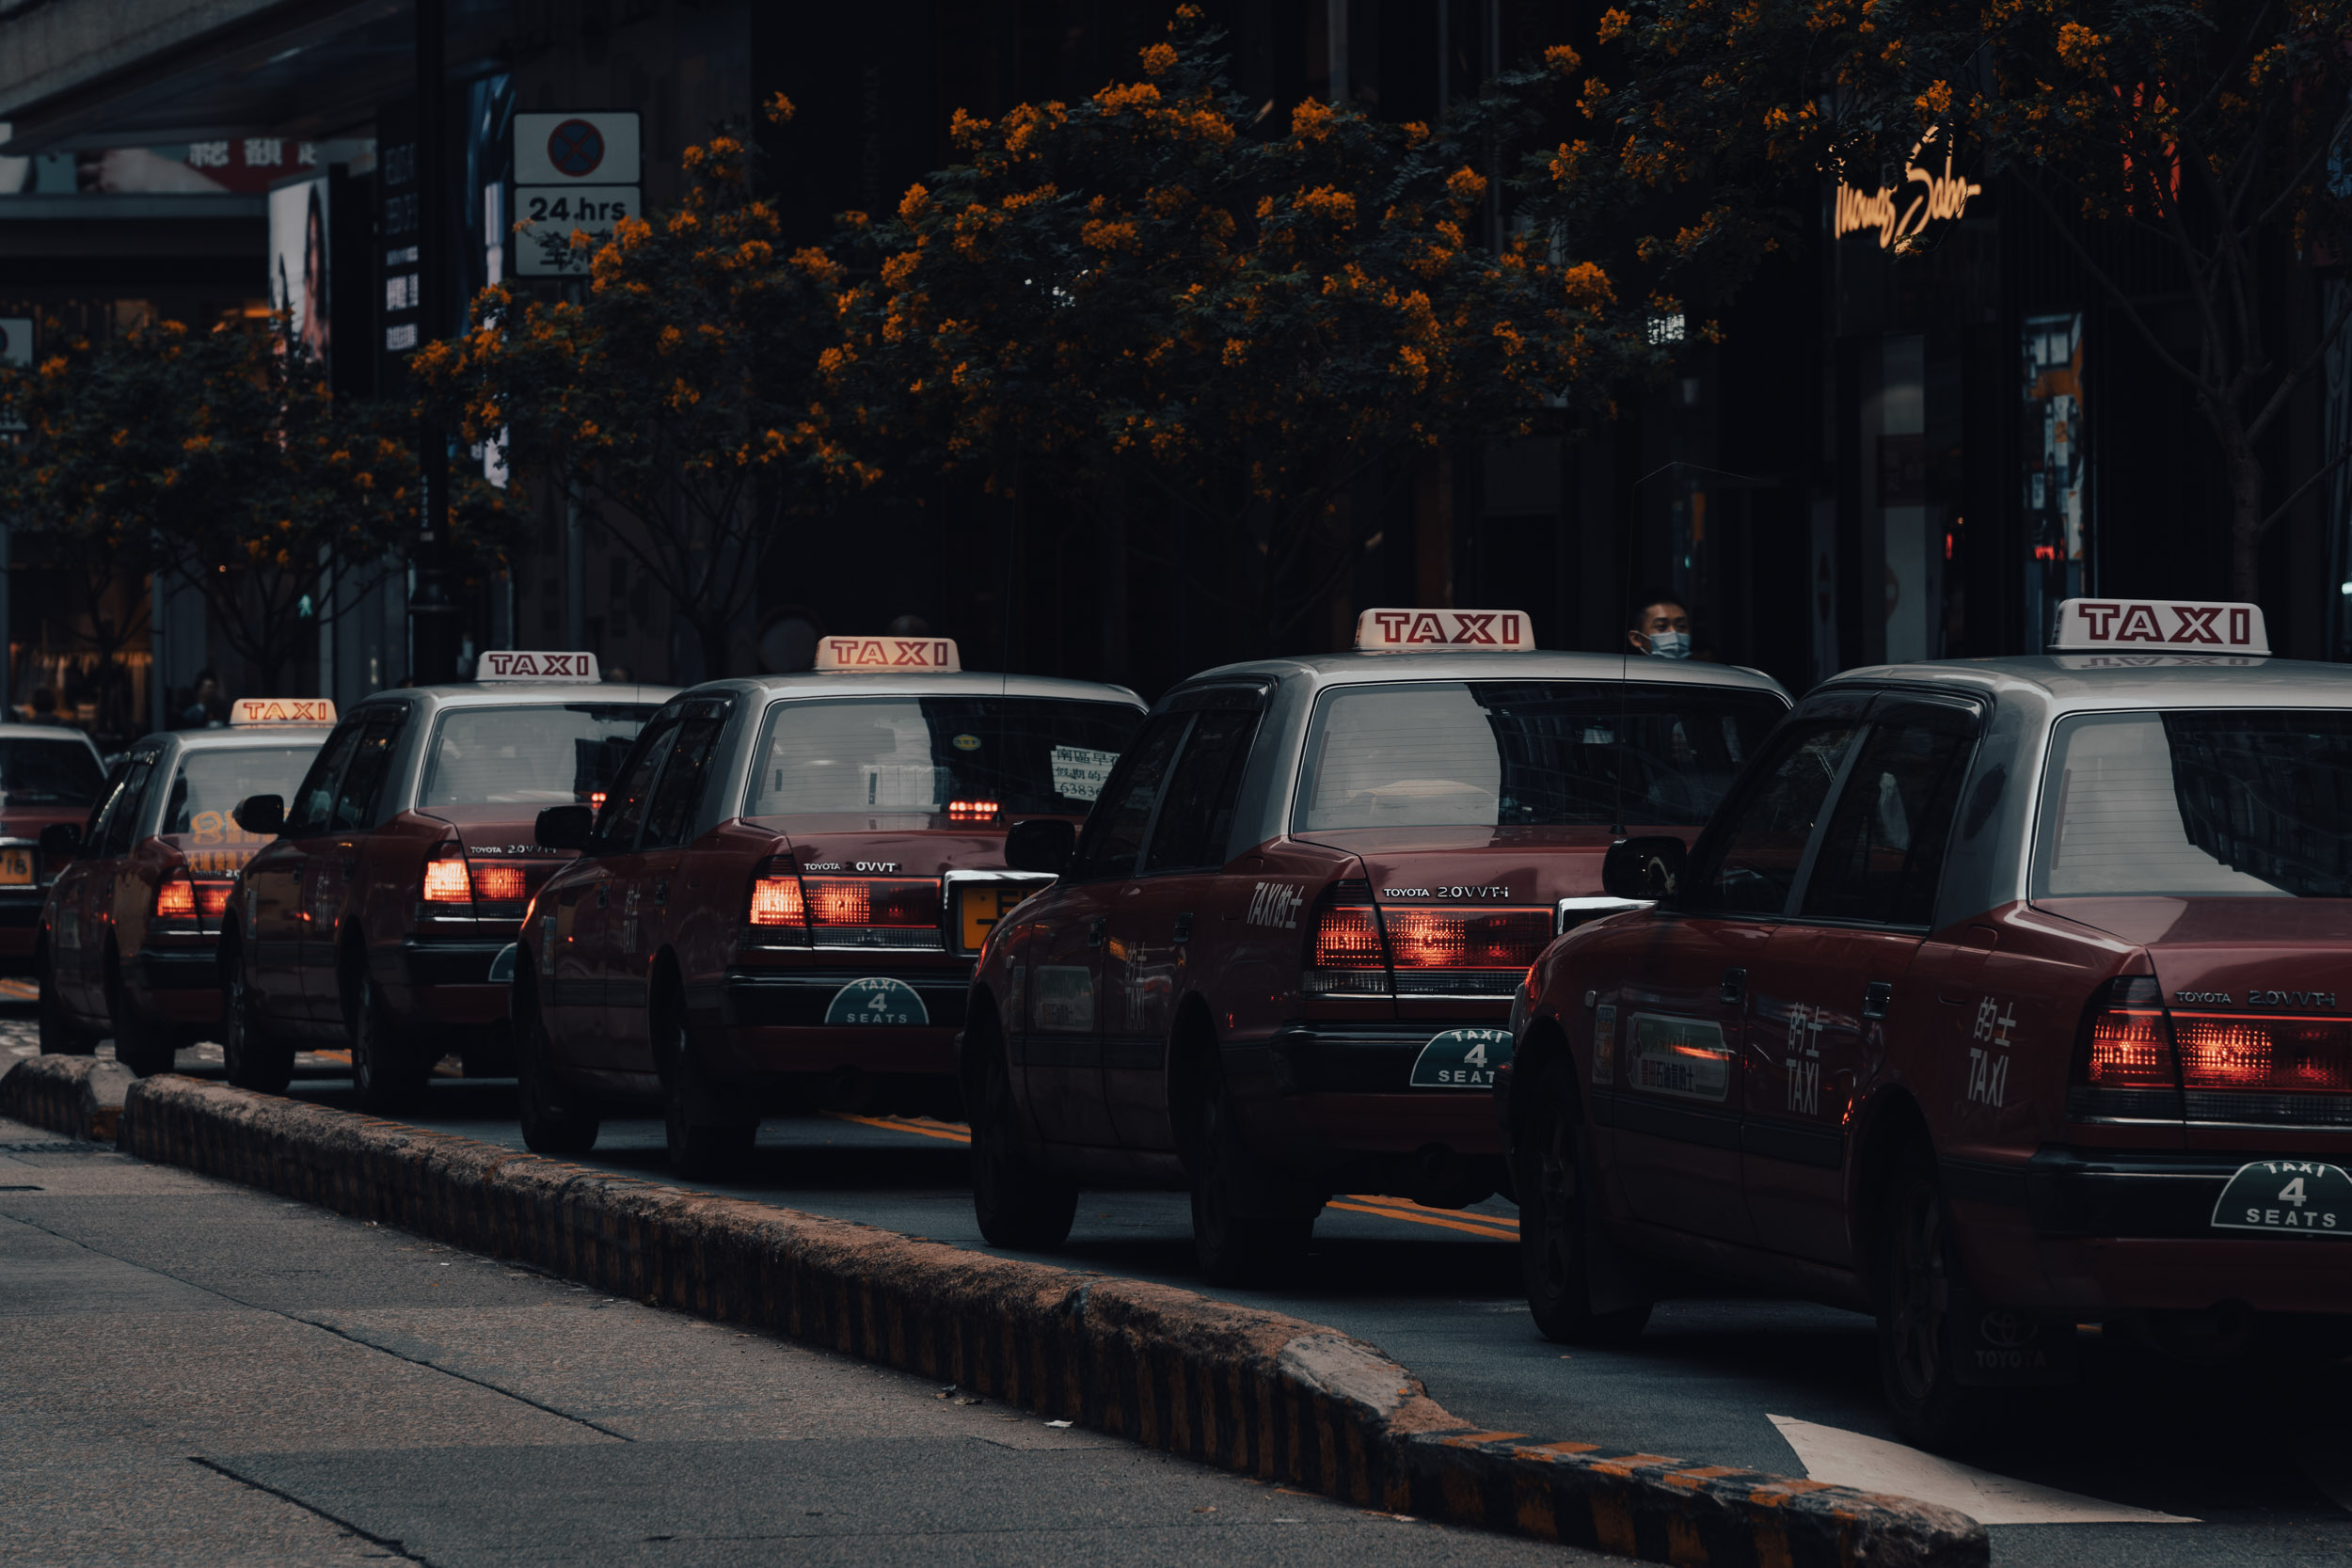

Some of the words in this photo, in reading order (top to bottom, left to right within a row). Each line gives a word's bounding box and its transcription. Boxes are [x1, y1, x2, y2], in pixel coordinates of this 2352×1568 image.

[1375, 612, 1520, 645] TAXI
[2078, 603, 2250, 645] TAXI
[830, 640, 949, 667] TAXI
[488, 654, 590, 676] TAXI
[243, 702, 327, 721] TAXI
[469, 846, 503, 854] TOYOTA
[803, 863, 842, 871] TOYOTA
[1383, 888, 1432, 898] TOYOTA
[857, 979, 897, 992] TAXI
[867, 992, 888, 1013] 4
[2174, 990, 2233, 1005] TOYOTA
[847, 1012, 909, 1024] SEATS
[1973, 995, 2018, 1048] 的士
[1451, 1030, 1503, 1043] TAXI
[1787, 1002, 1823, 1058] 的士
[1463, 1043, 1488, 1069] 4
[1438, 1069, 1495, 1084] SEAT
[1967, 1047, 2010, 1108] TAXI
[1786, 1058, 1820, 1117] TAXI
[2263, 1162, 2325, 1178] TAXI
[2278, 1177, 2307, 1208] 4
[2246, 1208, 2337, 1227] SEATS
[1975, 1350, 2048, 1370] TOYOTA
